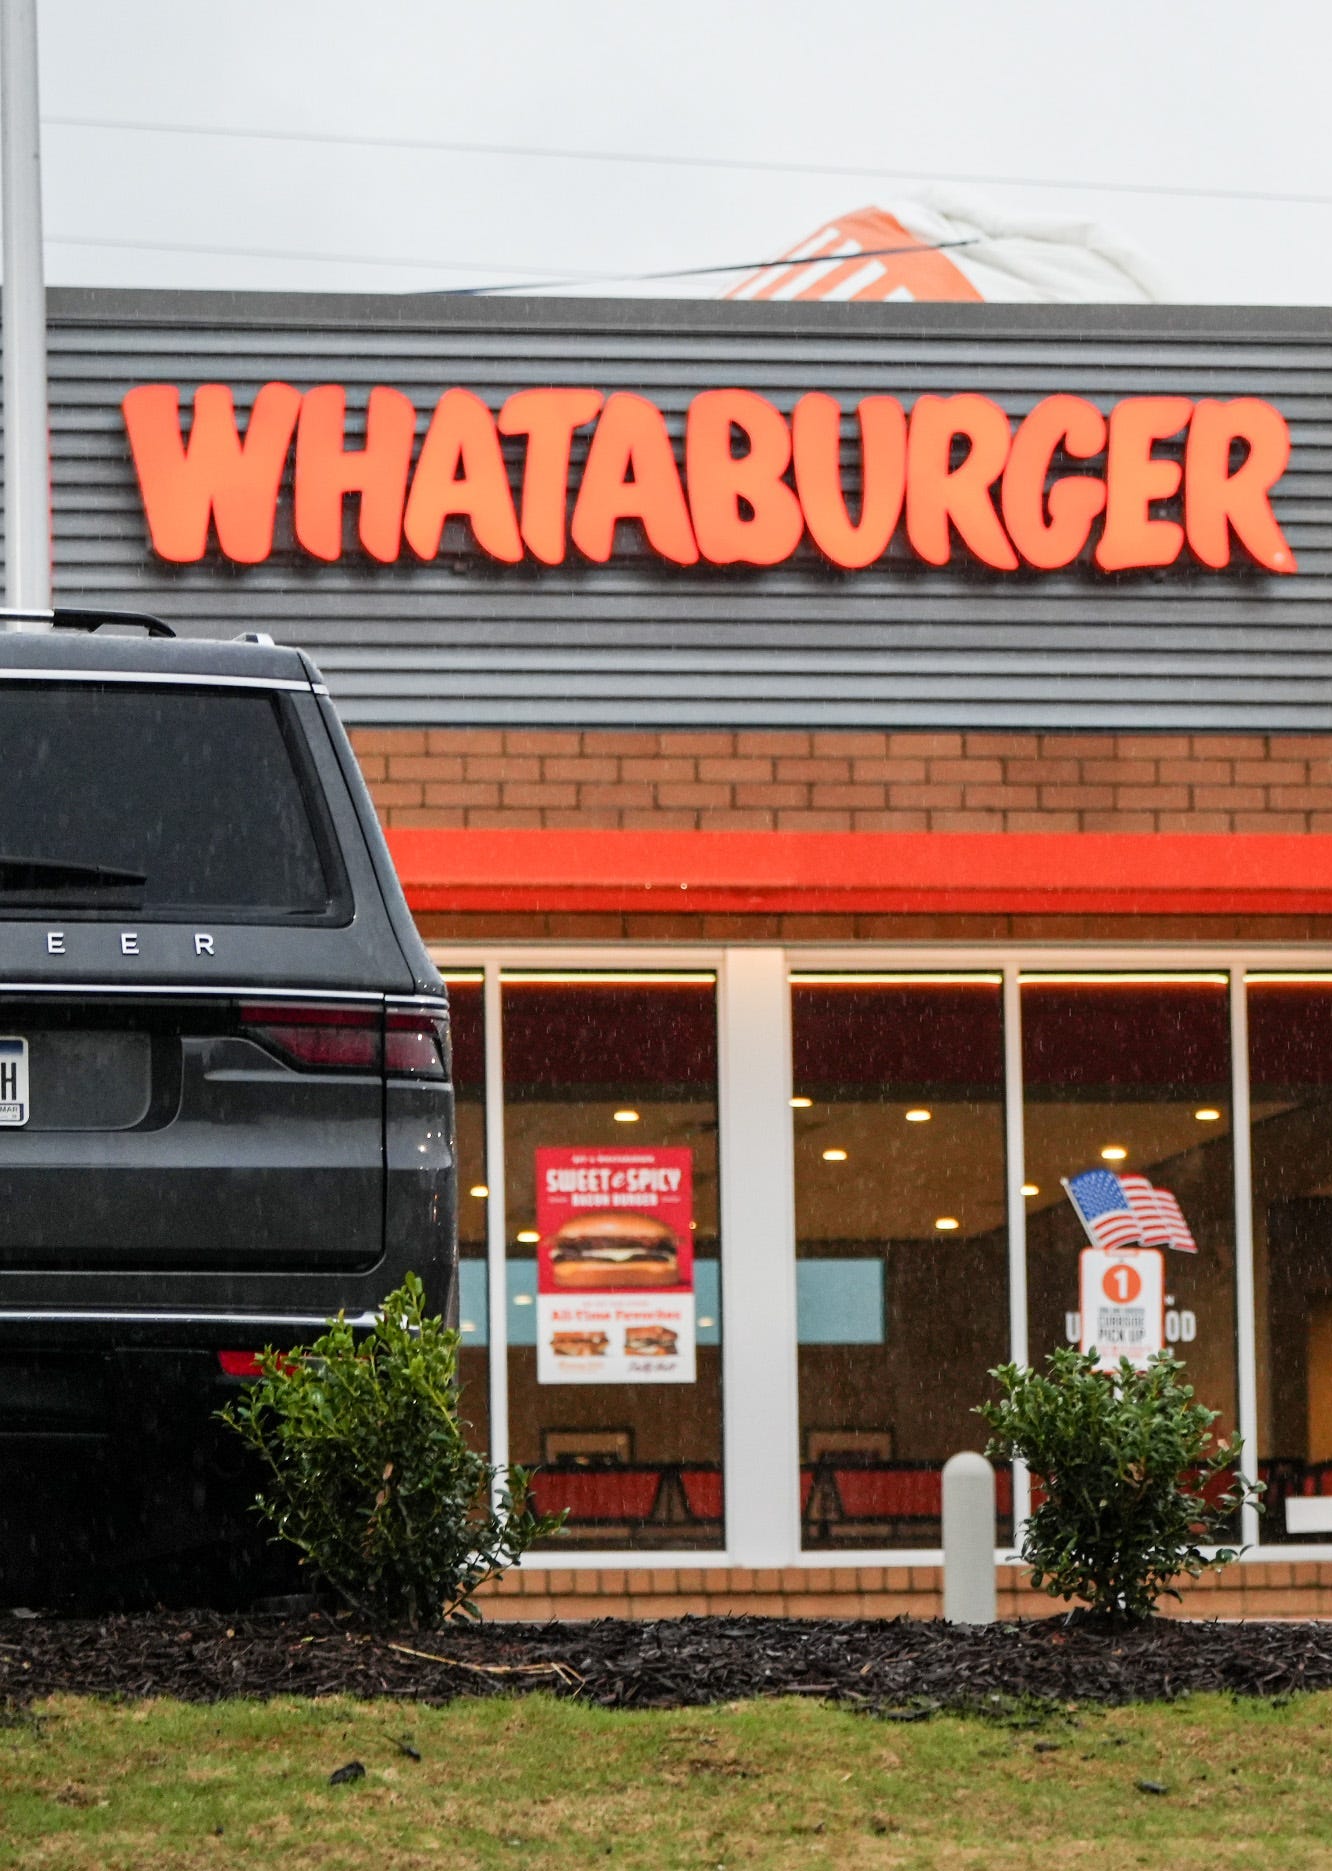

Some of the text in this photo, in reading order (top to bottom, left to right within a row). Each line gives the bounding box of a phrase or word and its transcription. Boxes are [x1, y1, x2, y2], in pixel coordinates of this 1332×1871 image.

[124, 382, 1297, 574] WHATABURGER
[47, 932, 215, 956] EER
[0, 1062, 17, 1101] H
[546, 1168, 610, 1192] SWEET
[627, 1168, 682, 1192] SPICY
[1113, 1269, 1128, 1299] 1
